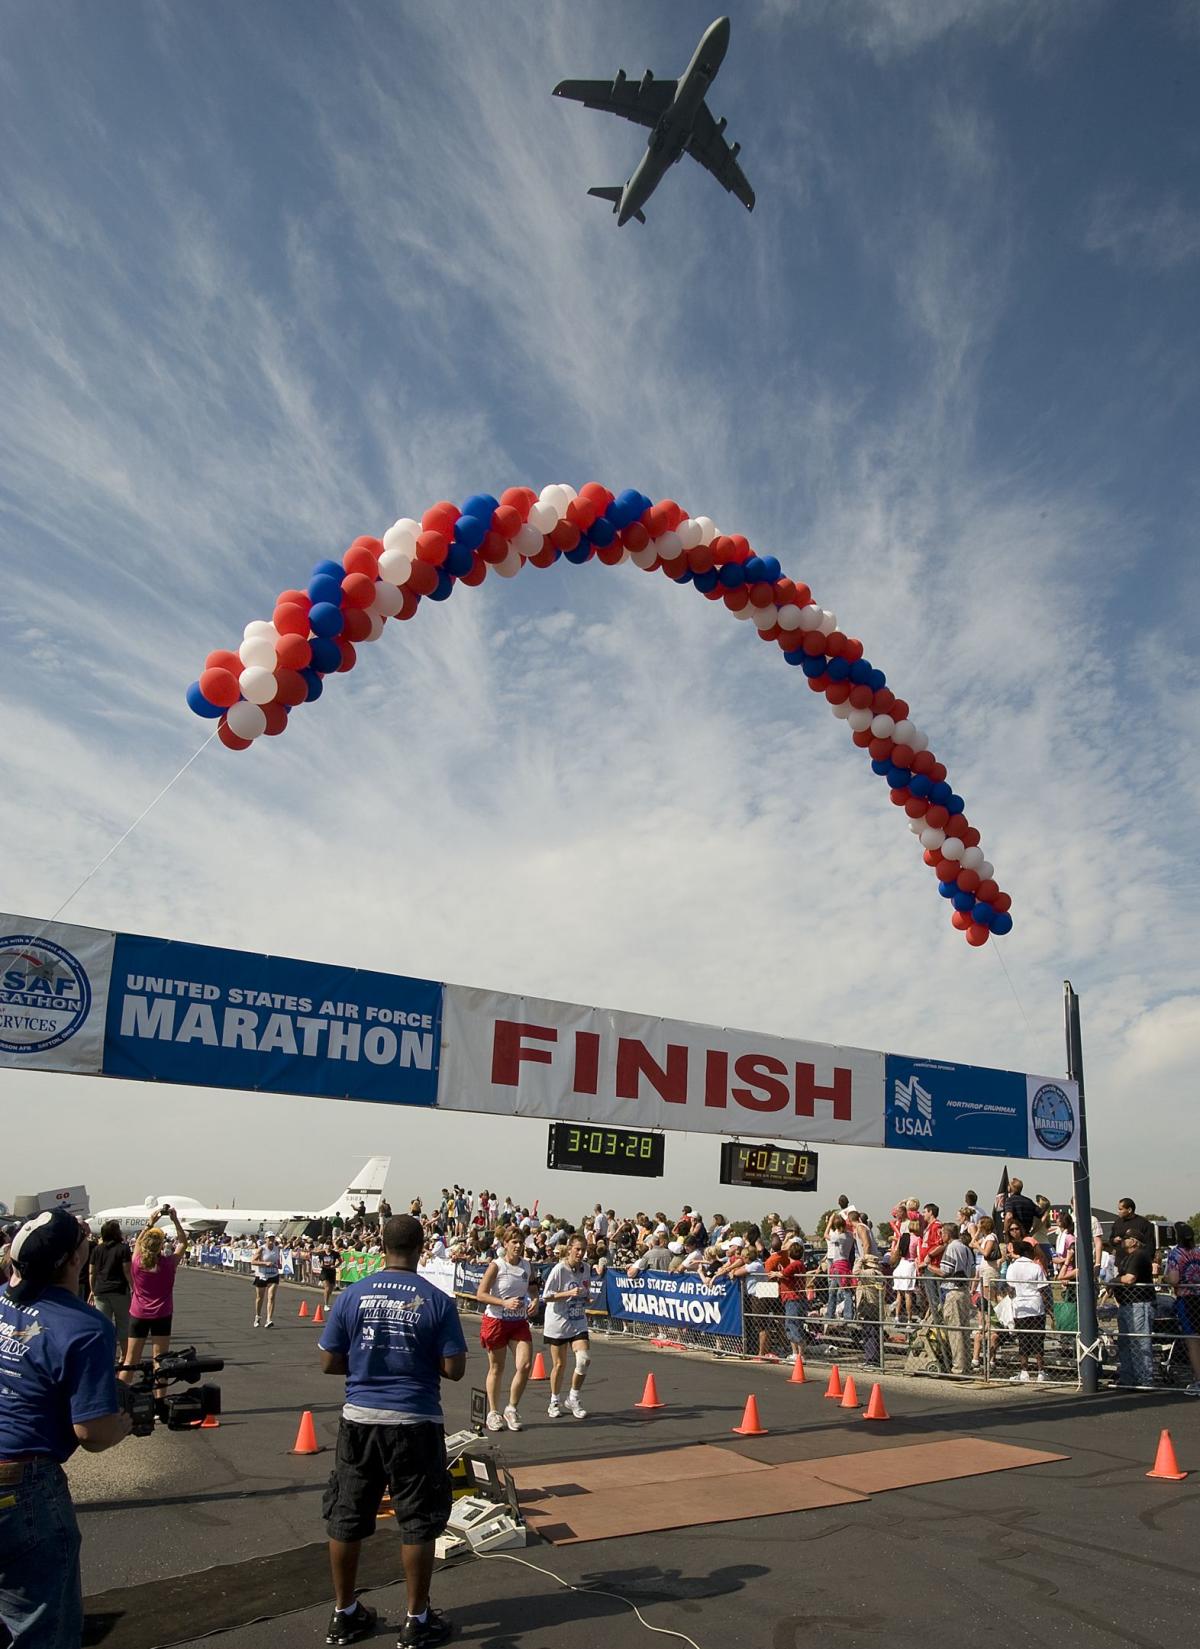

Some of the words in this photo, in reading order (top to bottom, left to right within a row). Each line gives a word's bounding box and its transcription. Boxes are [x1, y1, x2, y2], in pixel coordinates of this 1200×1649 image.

[127, 974, 220, 1000] UNITED
[228, 988, 312, 1013] STATES
[318, 1000, 359, 1019] AIR
[366, 1007, 432, 1029] FORCE
[119, 993, 433, 1071] MARATHON
[490, 1019, 852, 1121] FINISH
[946, 1100, 983, 1110] NORTHROP
[983, 1104, 1016, 1113] GRUMMAN
[895, 1116, 933, 1137] USAA
[1034, 1116, 1073, 1134] MARATHON
[55, 1192, 70, 1200] GO
[372, 1282, 417, 1292] VOLUNTEER
[616, 1277, 645, 1289] UNITED
[647, 1278, 677, 1293] STATES
[678, 1283, 694, 1295] AIR
[695, 1283, 727, 1297] FORCE
[359, 1299, 376, 1309] AIR
[376, 1299, 405, 1310] FORCE
[621, 1292, 722, 1324] MARATHON
[363, 1308, 421, 1324] MARATHON
